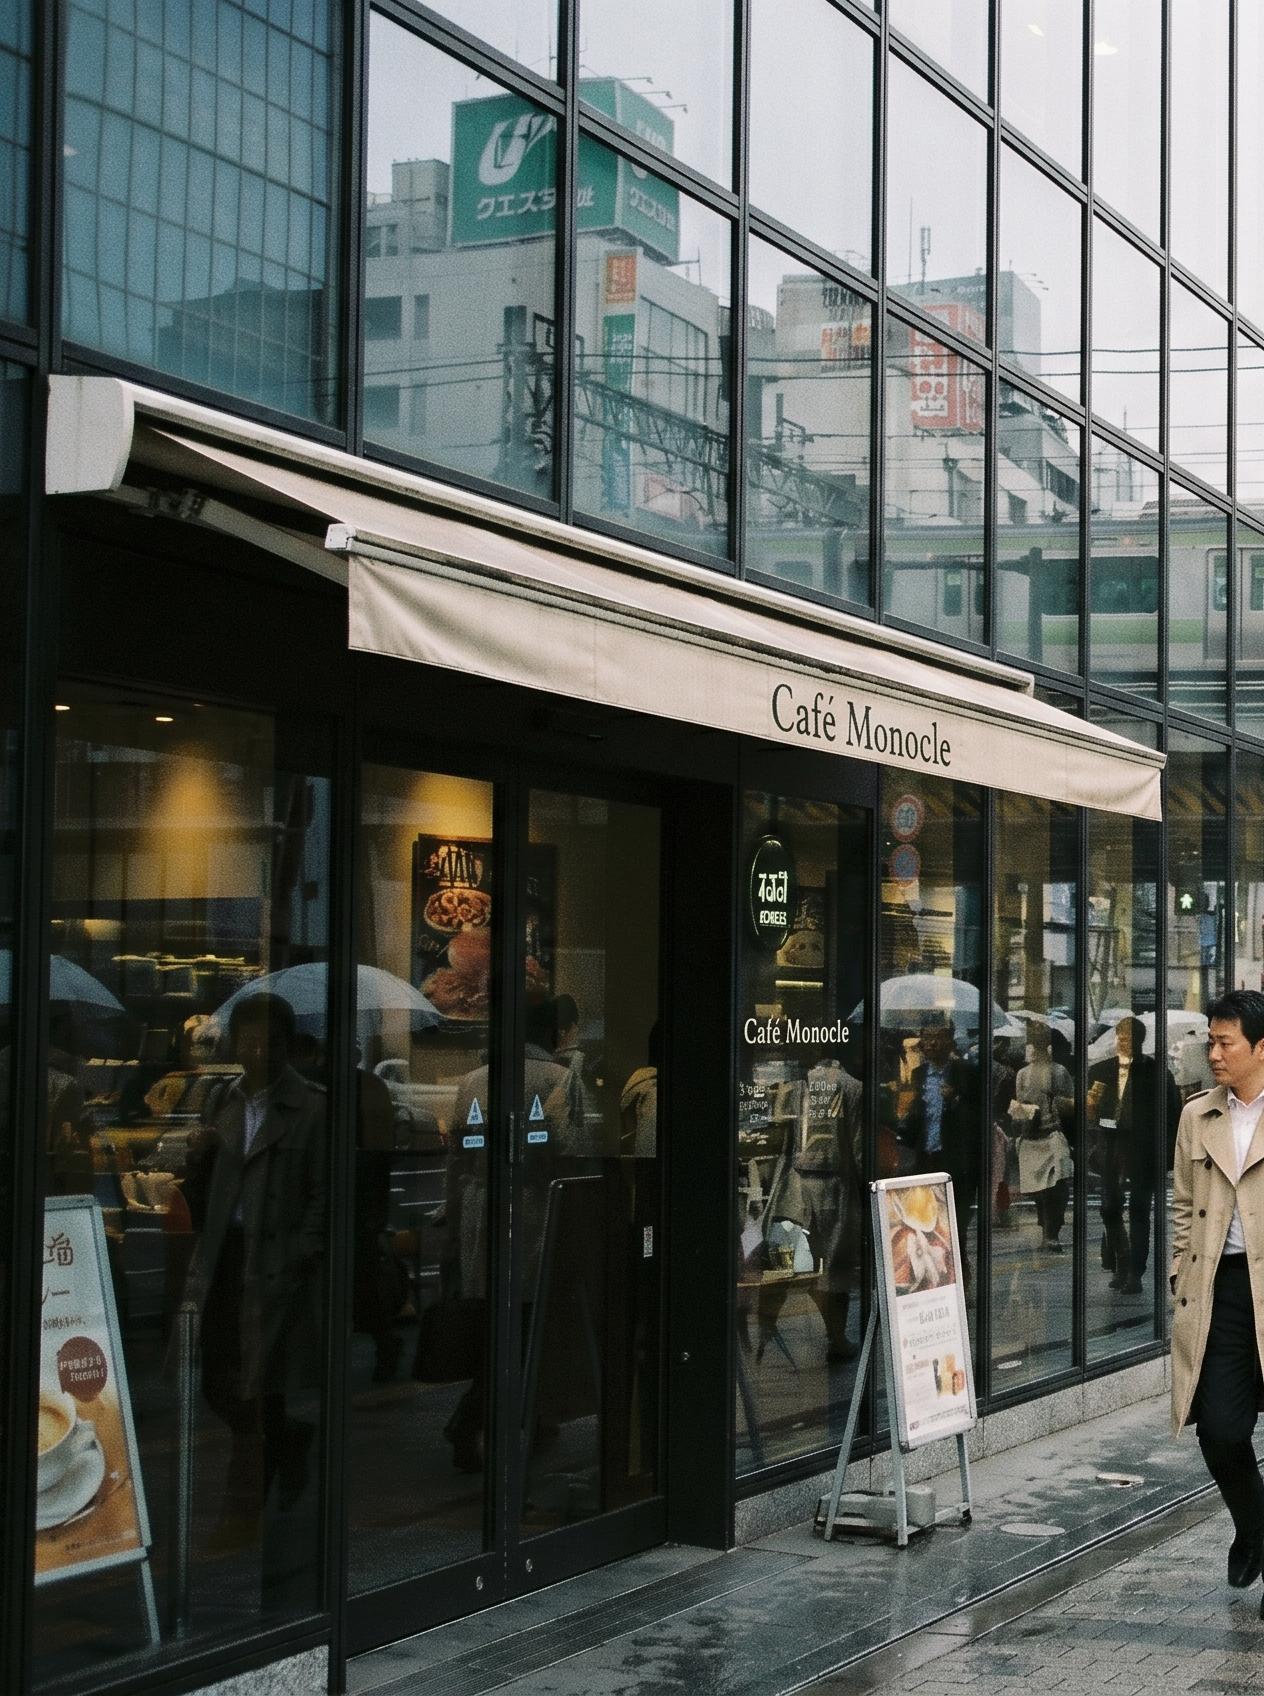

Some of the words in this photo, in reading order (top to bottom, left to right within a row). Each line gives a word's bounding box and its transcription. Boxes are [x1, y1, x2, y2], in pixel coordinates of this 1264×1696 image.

[771, 683, 836, 742] Café
[846, 701, 952, 767] Monocle
[743, 1015, 781, 1044] Café
[786, 1018, 850, 1044] Monocle
